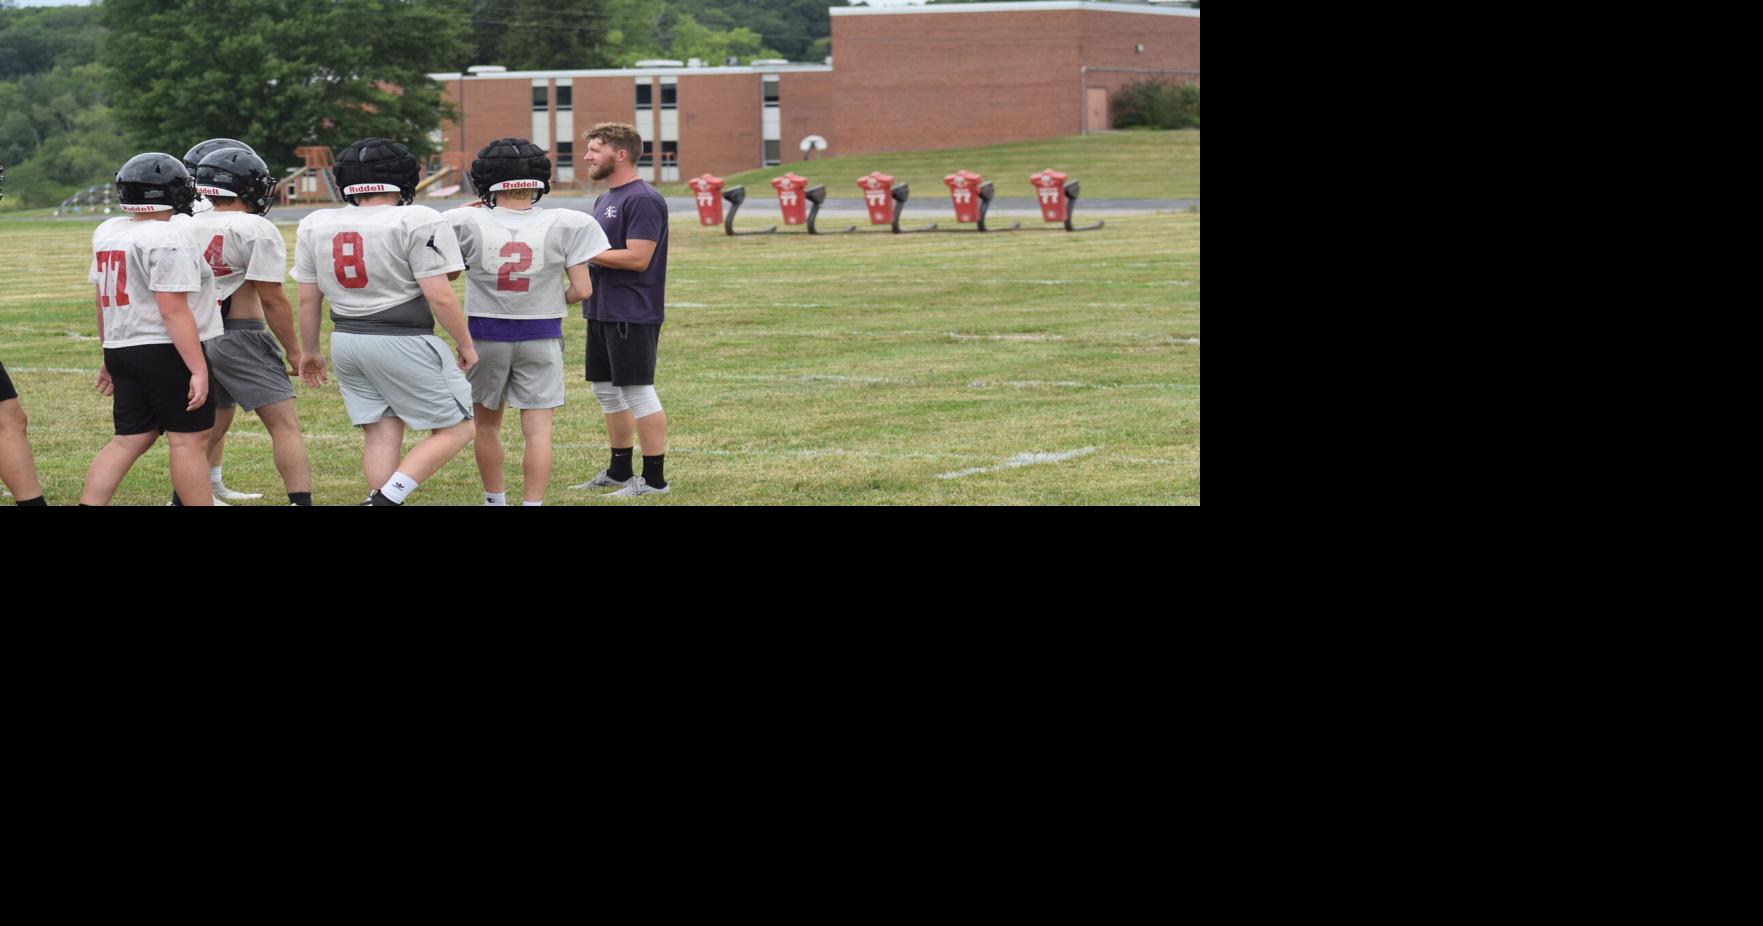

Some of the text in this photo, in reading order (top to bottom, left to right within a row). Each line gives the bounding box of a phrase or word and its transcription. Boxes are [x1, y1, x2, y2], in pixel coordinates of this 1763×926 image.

[348, 185, 385, 193] Riddell
[502, 181, 538, 189] Riddell
[96, 249, 129, 308] 77
[203, 234, 233, 277] 4
[332, 231, 369, 289] 8
[496, 241, 534, 292] 2
